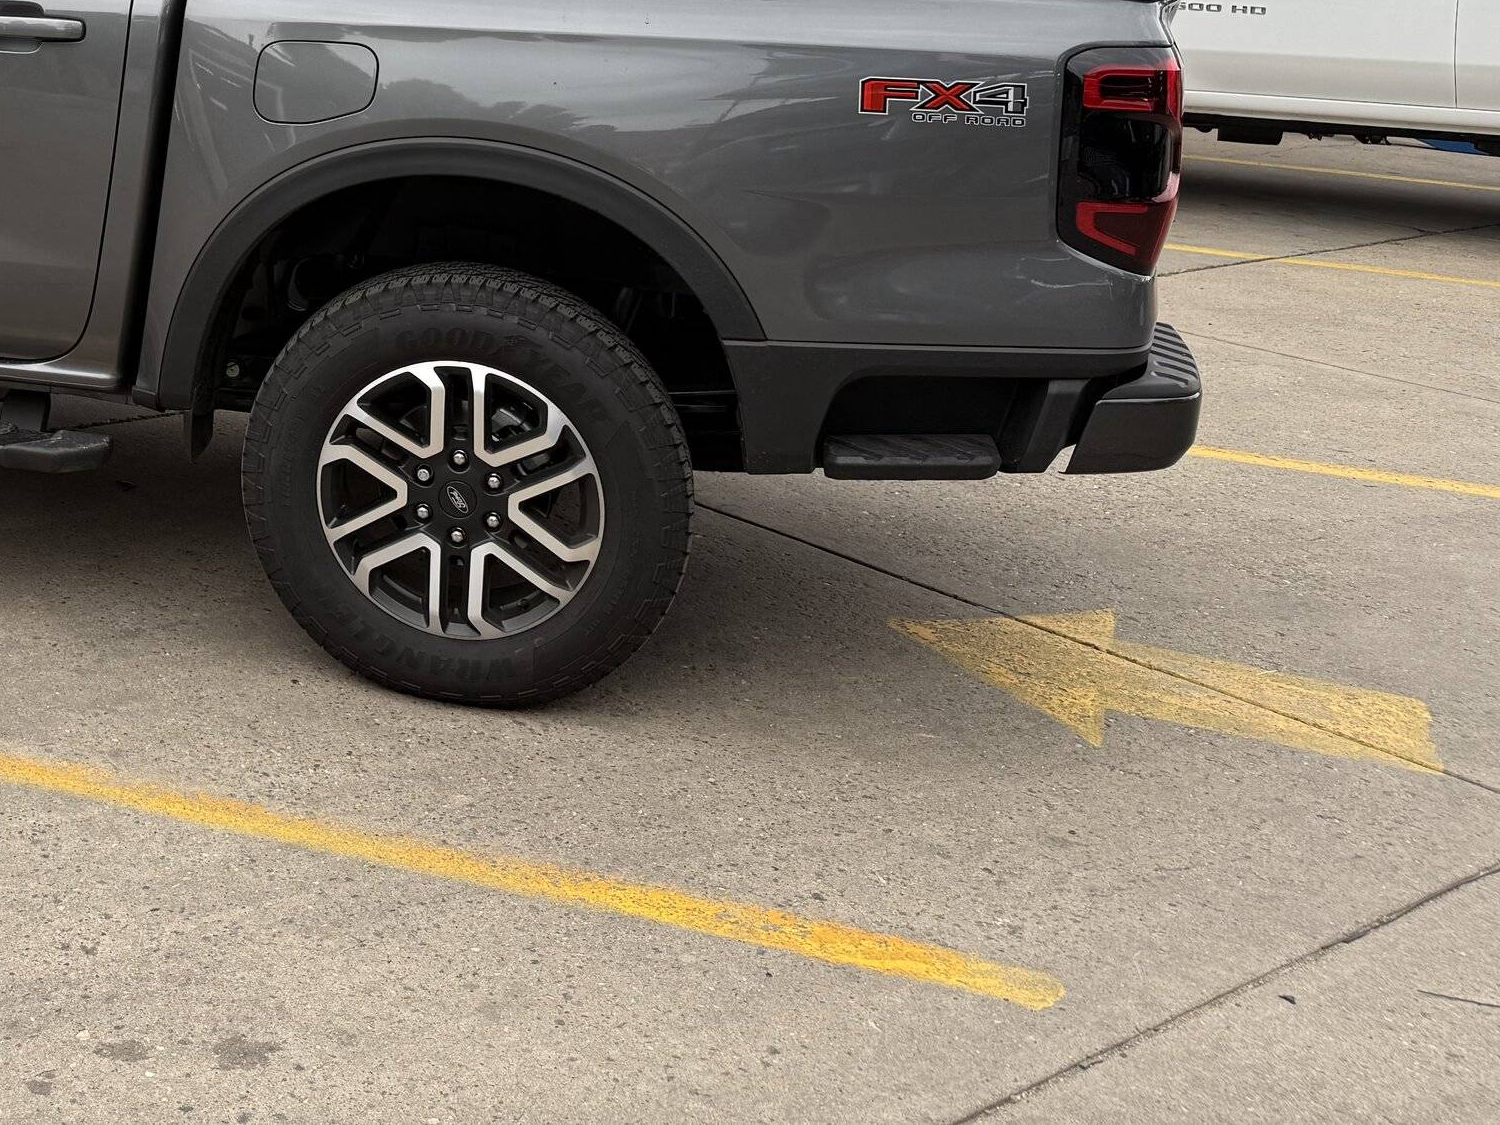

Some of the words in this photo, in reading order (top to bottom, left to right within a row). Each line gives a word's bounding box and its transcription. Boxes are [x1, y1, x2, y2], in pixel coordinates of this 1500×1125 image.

[1231, 4, 1267, 15] HD
[858, 76, 1029, 116] FX4
[911, 112, 958, 125] OFF
[964, 113, 1027, 129] ROAD
